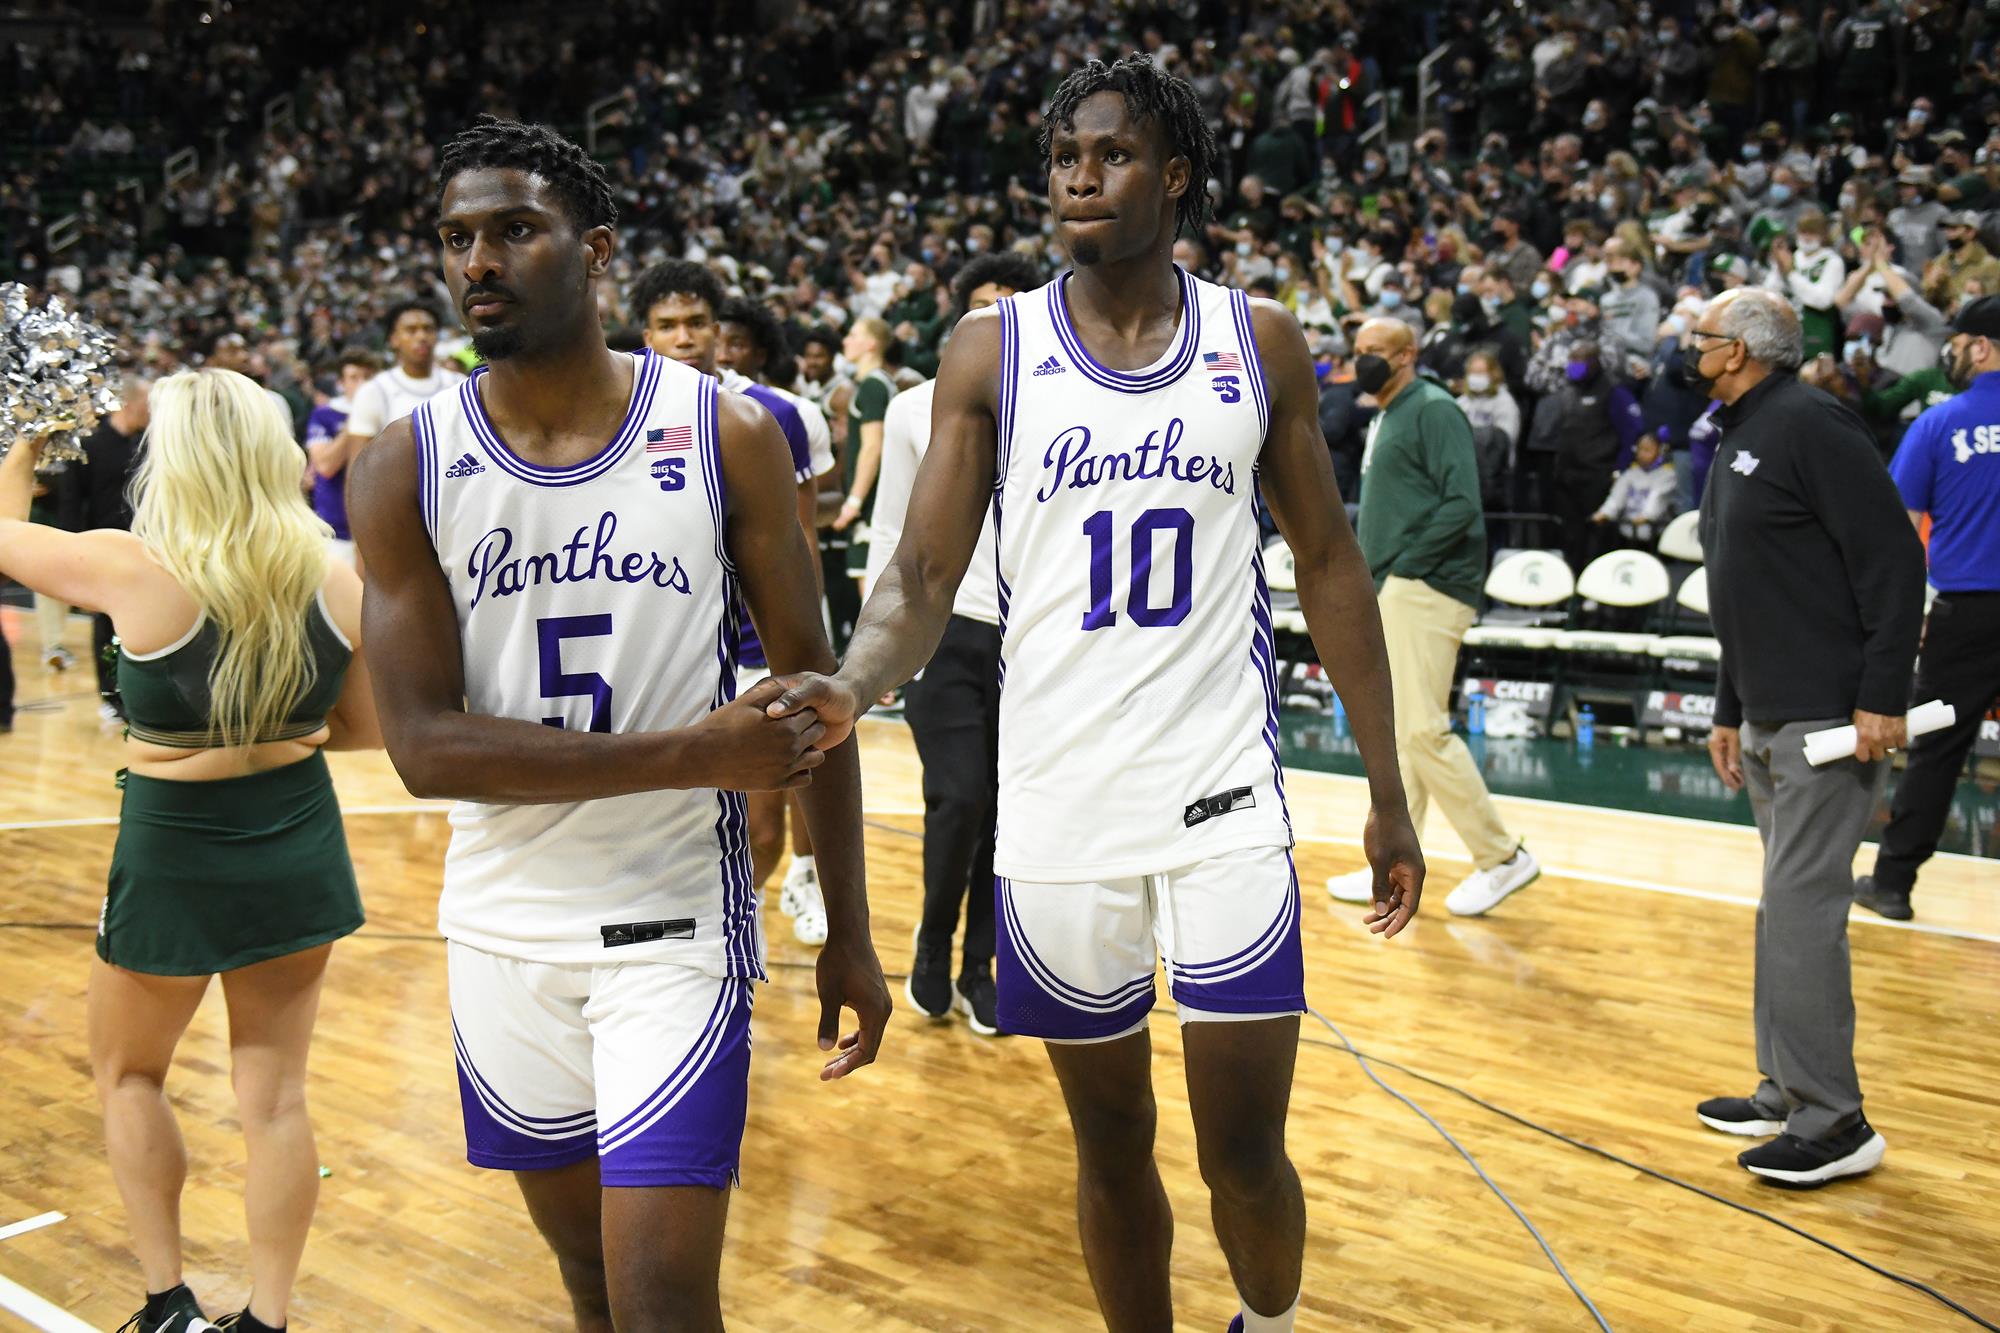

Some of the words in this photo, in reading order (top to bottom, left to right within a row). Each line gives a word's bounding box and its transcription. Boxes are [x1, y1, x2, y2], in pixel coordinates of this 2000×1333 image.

[1032, 366, 1066, 377] adidas
[1211, 380, 1227, 388] BIG
[1220, 375, 1241, 403] S
[445, 465, 486, 479] adidas
[650, 465, 670, 475] BIG
[660, 457, 686, 491] S
[1036, 417, 1235, 503] Panthers
[467, 511, 692, 611] Panthers
[1081, 507, 1195, 631] 10
[536, 613, 613, 733] 5
